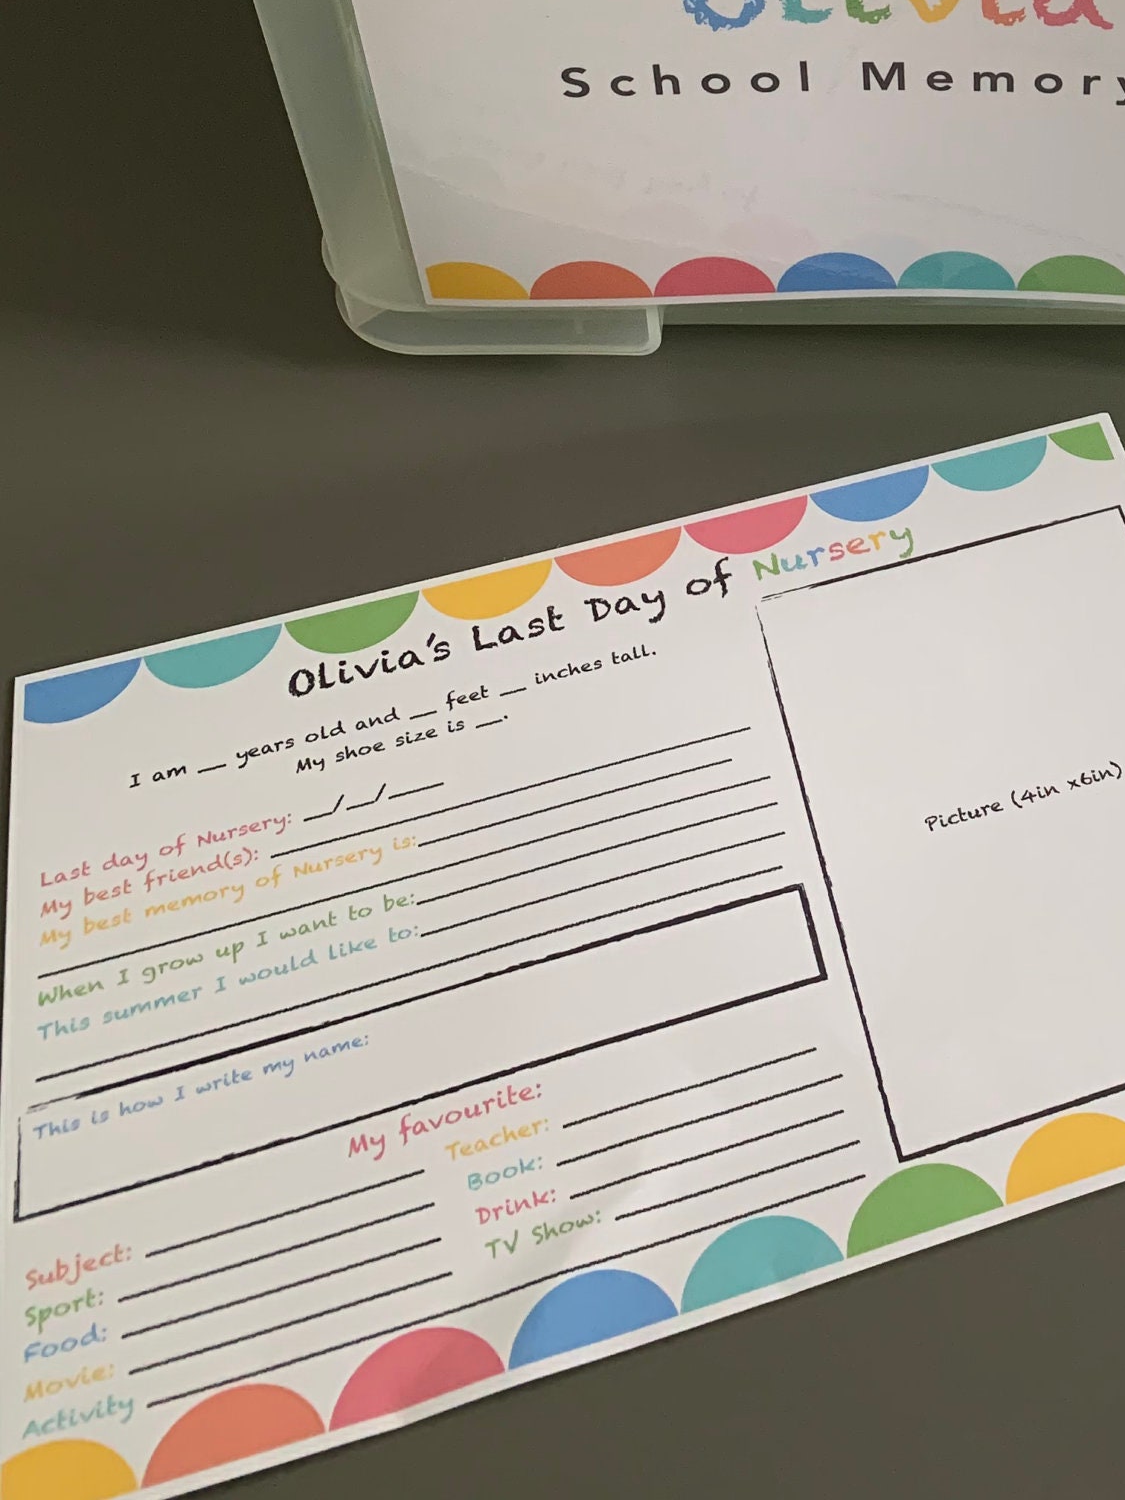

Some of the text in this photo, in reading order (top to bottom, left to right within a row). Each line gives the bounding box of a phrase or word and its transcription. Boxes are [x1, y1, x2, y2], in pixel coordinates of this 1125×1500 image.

[560, 60, 810, 99] School
[288, 527, 914, 698] Olivia's Last Day of Nursery
[129, 644, 656, 788] I am years old and feet inches tall.
[296, 720, 465, 774] My shoe size is
[923, 802, 1005, 832] Picture
[41, 813, 291, 887] Last day of Nursery:
[40, 847, 258, 920] My best friend(s):
[40, 836, 416, 950] My best memory of Nursery is:
[38, 894, 414, 1007] When I grow up I want to be:
[37, 926, 418, 1040] This summer I would like to:
[33, 1035, 368, 1140] This is how I write my name:
[348, 1083, 542, 1161] My favourite:
[445, 1120, 548, 1161] Teacher:
[468, 1156, 542, 1191] Book:
[475, 1189, 556, 1225] Drink:
[485, 1210, 601, 1259] TV Show:
[26, 1244, 131, 1290] Subject:
[25, 1288, 104, 1335] Sport:
[24, 1322, 107, 1363] Food:
[24, 1364, 113, 1402] Movie:
[23, 1395, 133, 1439] Activity
